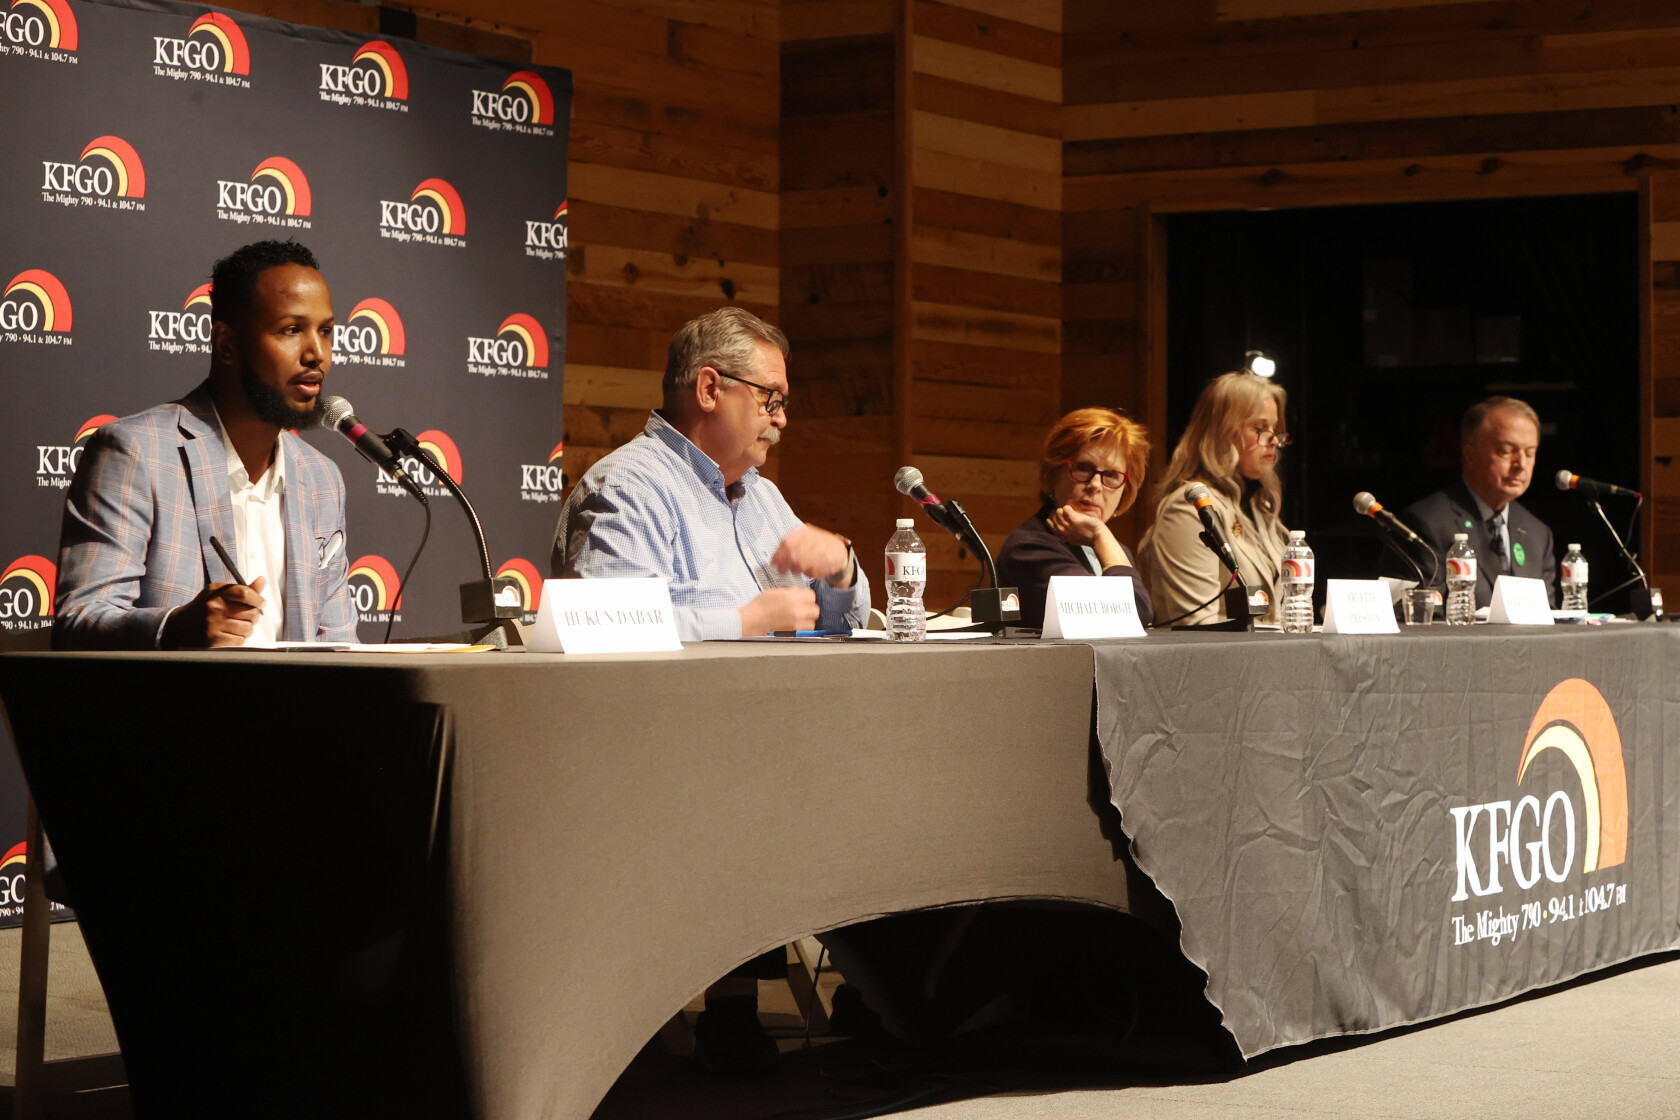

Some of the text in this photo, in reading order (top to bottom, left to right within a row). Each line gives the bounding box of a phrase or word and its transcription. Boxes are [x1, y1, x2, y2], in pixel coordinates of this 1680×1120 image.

[0, 11, 44, 46] GO
[12, 46, 24, 55] 790
[29, 48, 42, 59] 94.1
[51, 52, 68, 62] 104.7
[69, 56, 78, 64] FM
[153, 36, 220, 71] KFGO
[153, 66, 165, 76] The
[166, 68, 189, 81] Mighty
[190, 70, 201, 80] 790
[319, 64, 380, 96] KFGO
[471, 90, 528, 122] KFGO
[42, 162, 112, 196] KFGO
[42, 192, 54, 202] The
[56, 193, 79, 207] Mighty
[81, 196, 92, 206] 790
[98, 198, 110, 208] 94.1
[119, 200, 136, 210] 104.7
[217, 180, 282, 214] KFGO
[217, 210, 228, 220] The
[230, 211, 252, 224] Mighty
[252, 214, 264, 224] 790
[380, 200, 439, 232] KFGO
[0, 300, 38, 330] GO
[148, 310, 212, 342] KFGO
[5, 333, 17, 342] 790
[23, 334, 36, 344] 94.1
[45, 335, 62, 344] 104.7
[148, 340, 160, 350] The
[162, 341, 184, 354] Mighty
[185, 344, 196, 352] 790
[332, 324, 377, 354] FGO
[467, 337, 523, 366] KFGO
[36, 476, 49, 487] The
[0, 588, 34, 618] GO
[617, 609, 664, 625] DABAR
[1060, 602, 1098, 614] MICHAEL
[18, 620, 32, 629] 94.1
[1450, 790, 1575, 902] KFGO
[0, 874, 26, 905] GO
[1452, 915, 1474, 946] The
[1476, 906, 1519, 946] Mighty
[1522, 901, 1540, 930] 790
[1549, 894, 1574, 923] 94.1
[1584, 883, 1615, 916] 104.7
